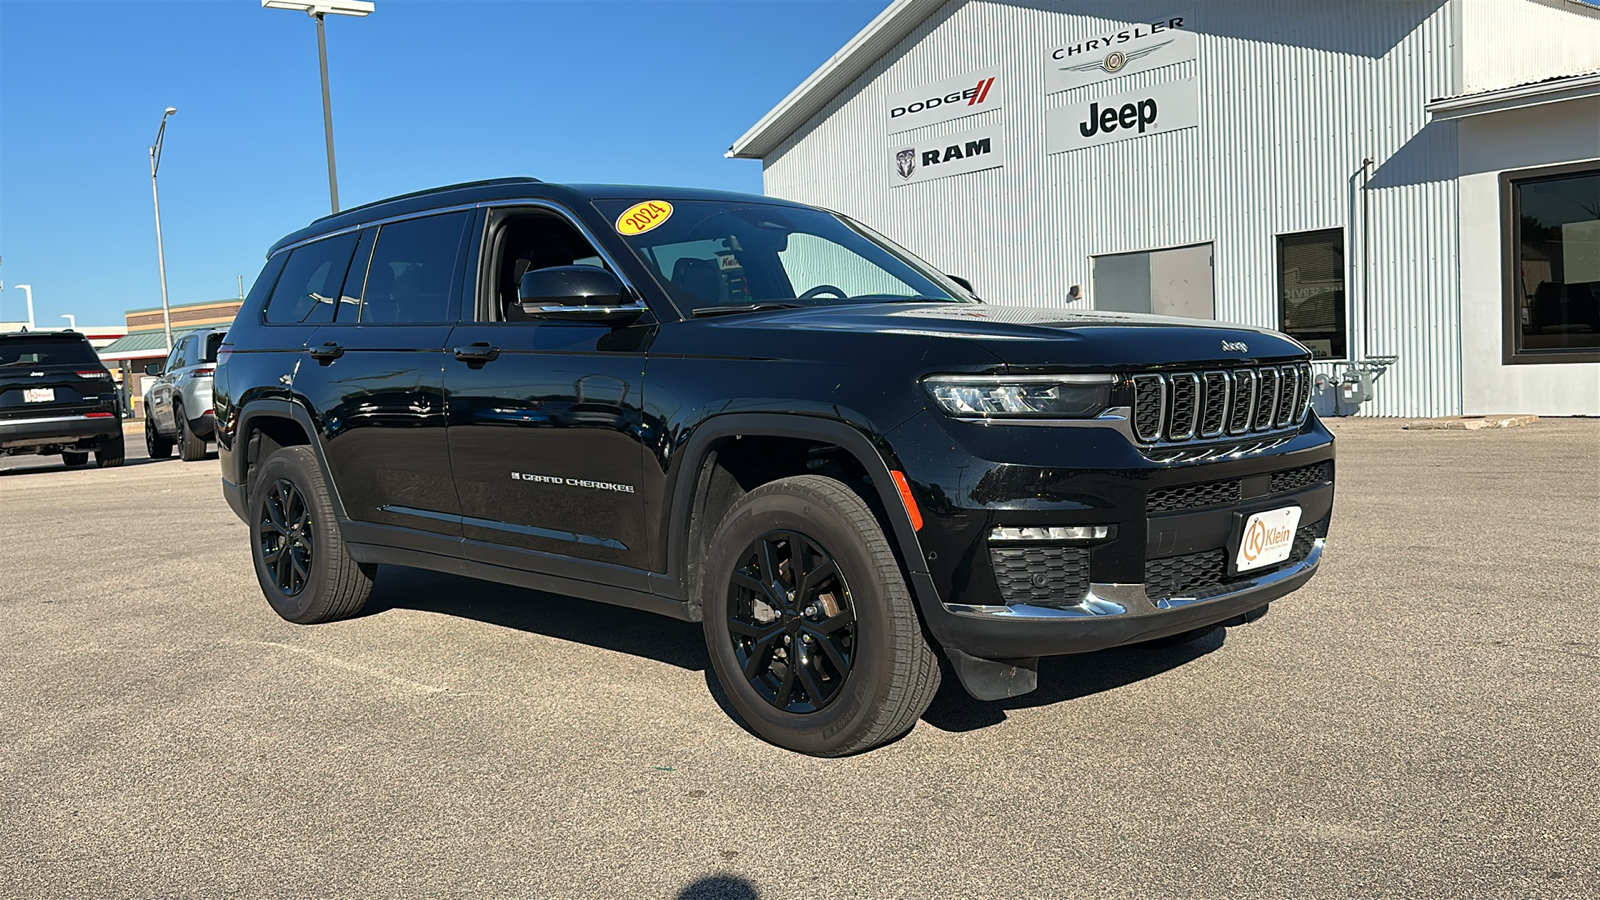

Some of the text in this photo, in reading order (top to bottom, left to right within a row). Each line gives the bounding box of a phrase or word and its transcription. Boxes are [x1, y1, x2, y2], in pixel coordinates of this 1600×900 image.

[1052, 16, 1185, 61] CHRYSLER
[890, 87, 979, 119] DODGE
[1079, 98, 1157, 138] Jeep
[921, 137, 992, 168] RAM
[625, 203, 667, 231] 2024
[1221, 339, 1248, 354] Jeep
[522, 473, 635, 493] GRAND CHEROKEE
[1265, 526, 1290, 547] Klein
